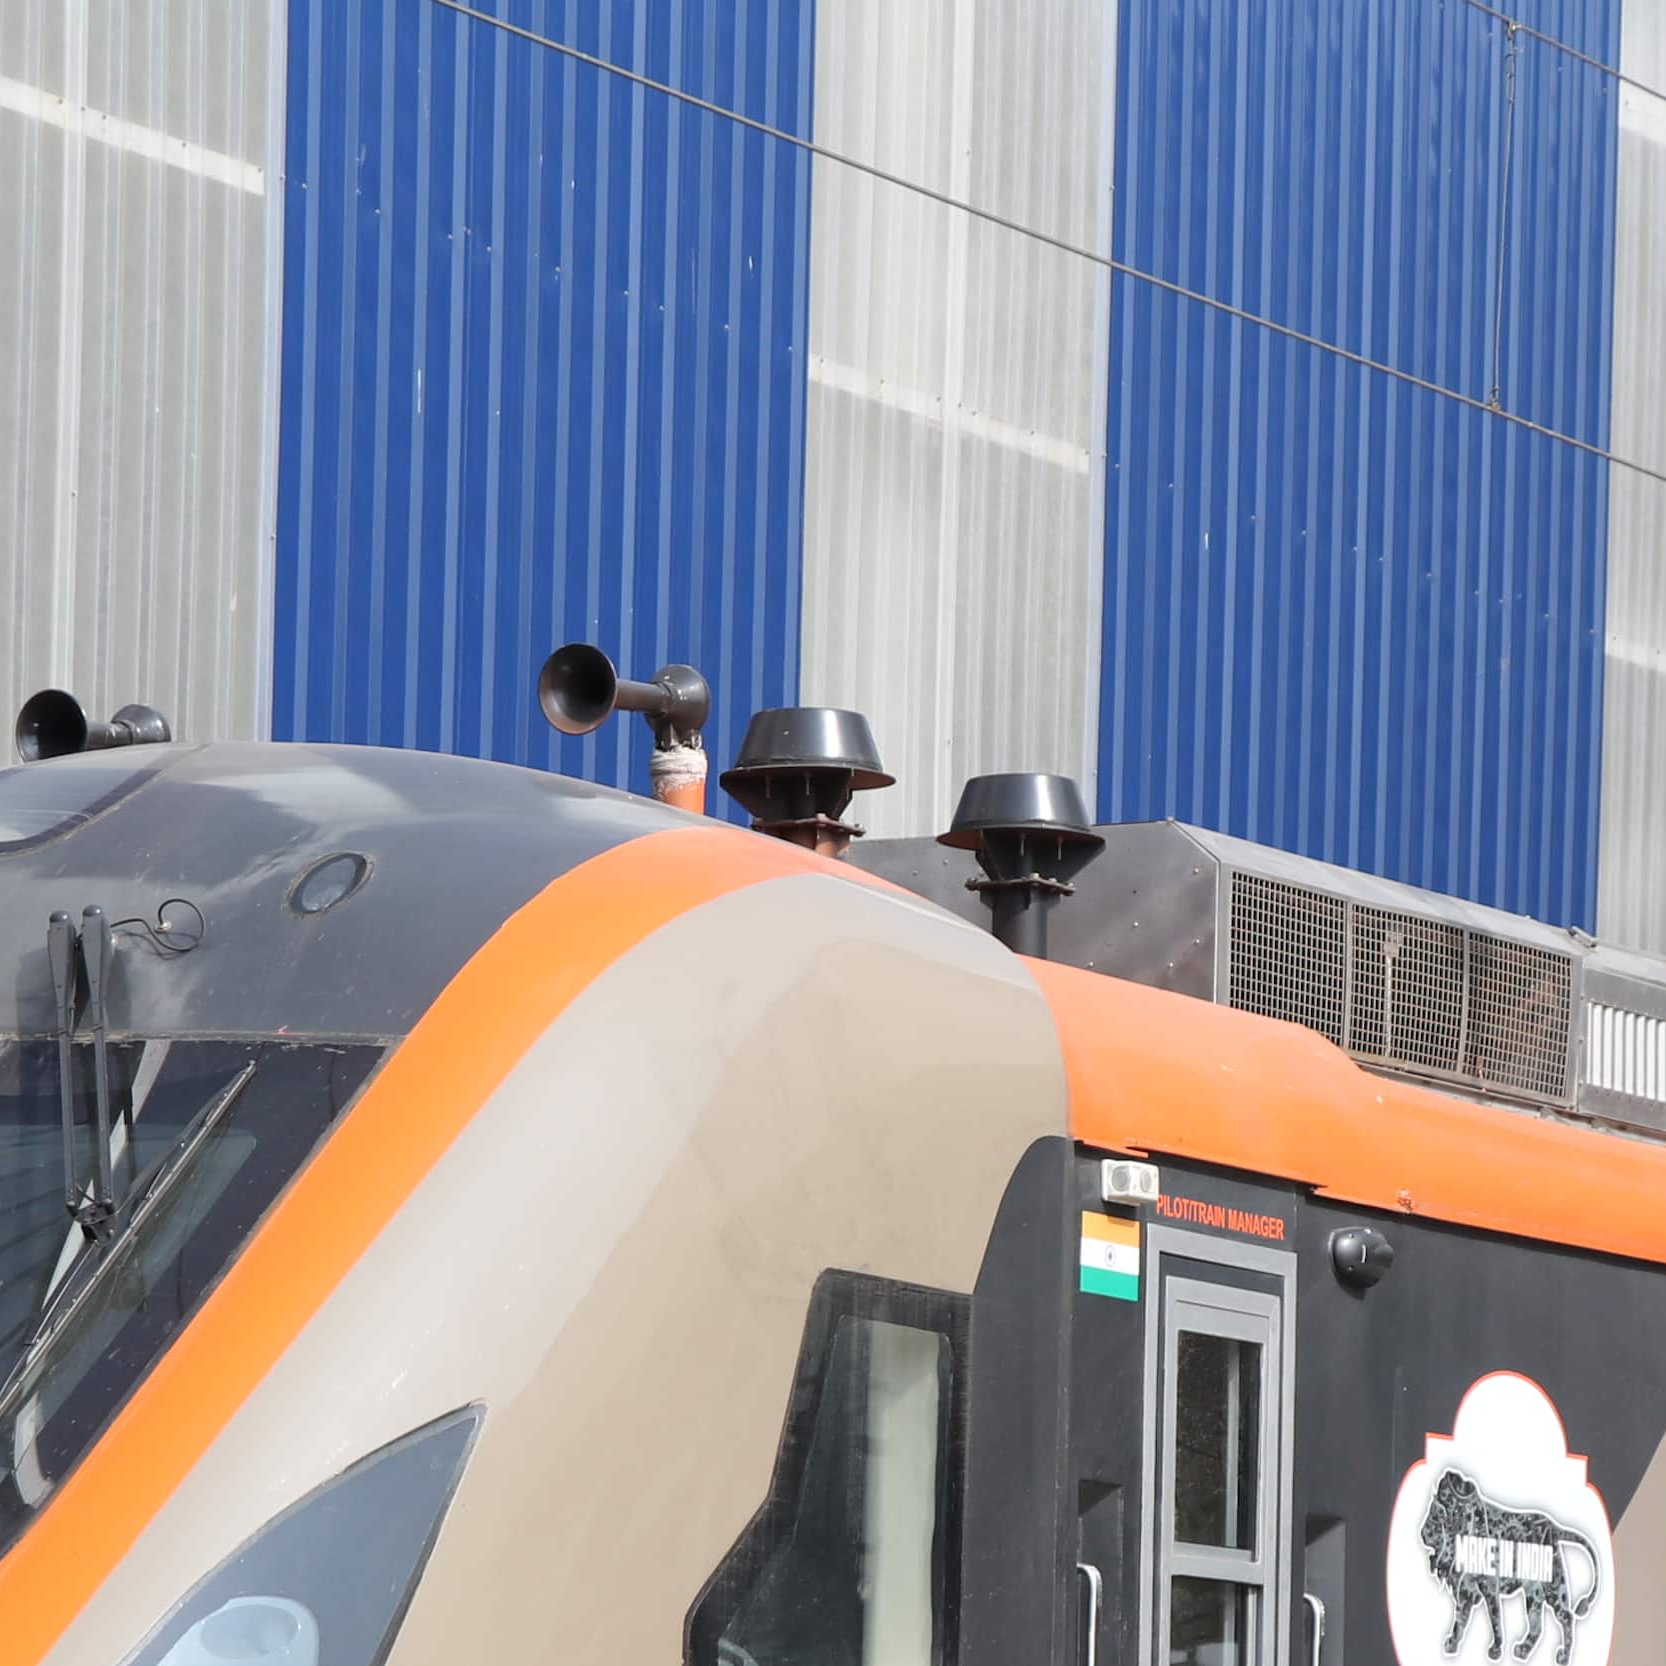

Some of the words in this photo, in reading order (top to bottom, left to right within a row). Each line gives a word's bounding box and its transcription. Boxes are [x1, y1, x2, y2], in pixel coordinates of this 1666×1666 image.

[1156, 1194, 1226, 1229] PILOT/TRAIN
[1228, 1208, 1285, 1240] MANAGER
[1454, 1533, 1497, 1576] MAKE
[1498, 1538, 1514, 1579] IN
[1515, 1541, 1553, 1583] INDIA
